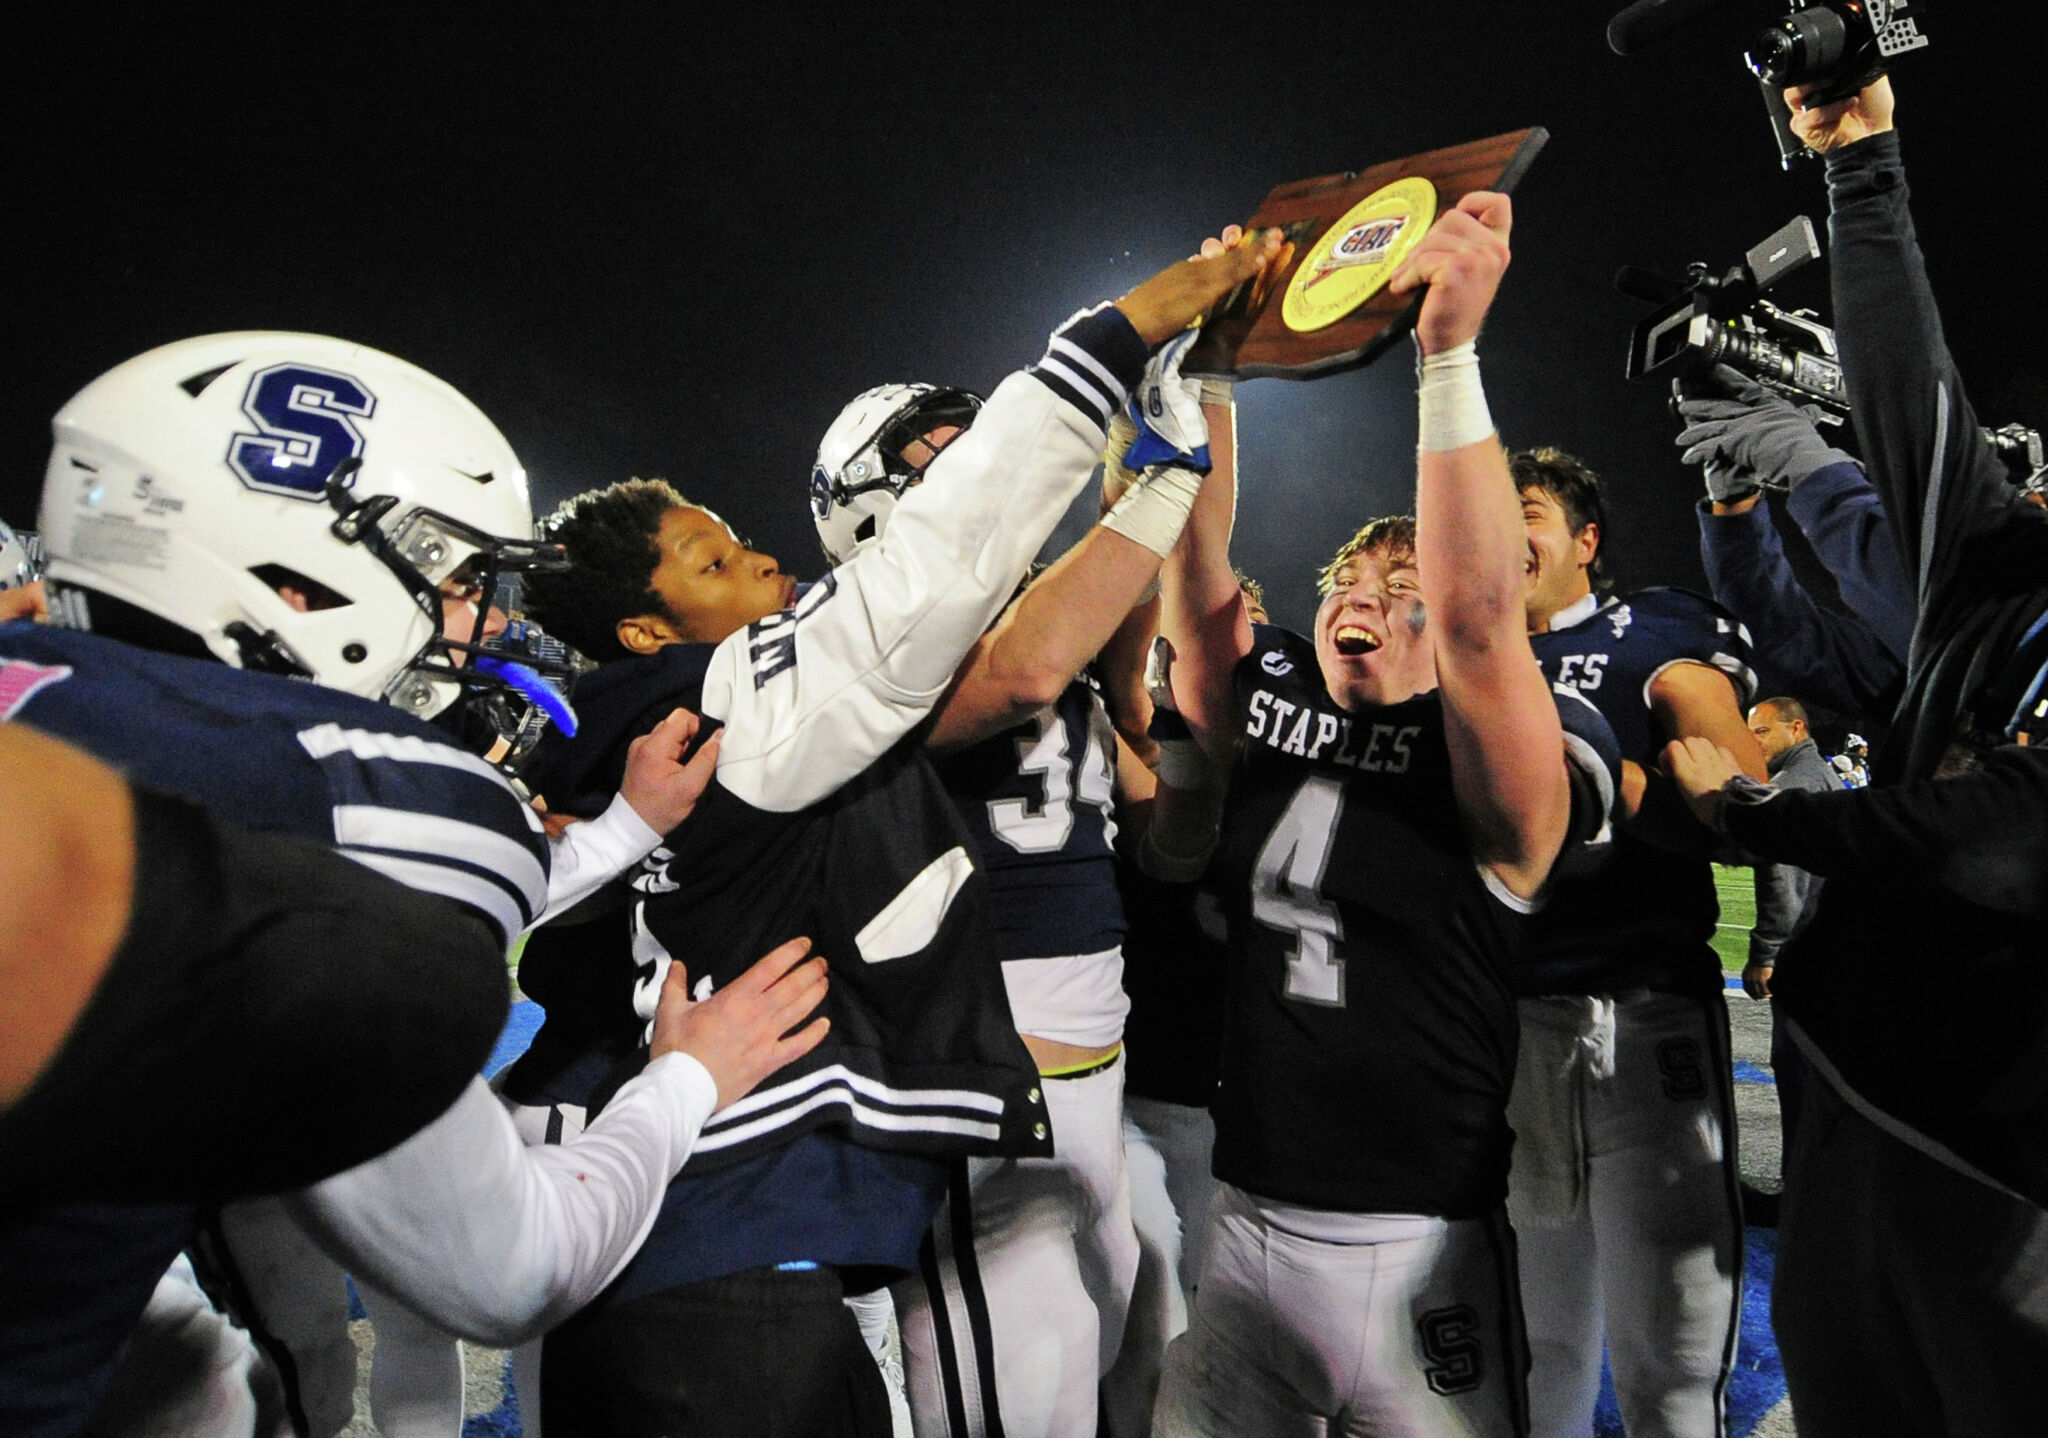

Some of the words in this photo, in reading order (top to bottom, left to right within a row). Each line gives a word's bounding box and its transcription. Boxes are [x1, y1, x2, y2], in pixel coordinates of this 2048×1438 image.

[226, 361, 378, 504] S
[986, 691, 1119, 854] 34
[1246, 689, 1422, 774] STAPLES
[1251, 775, 1347, 1009] 4
[1418, 1305, 1484, 1397] S
